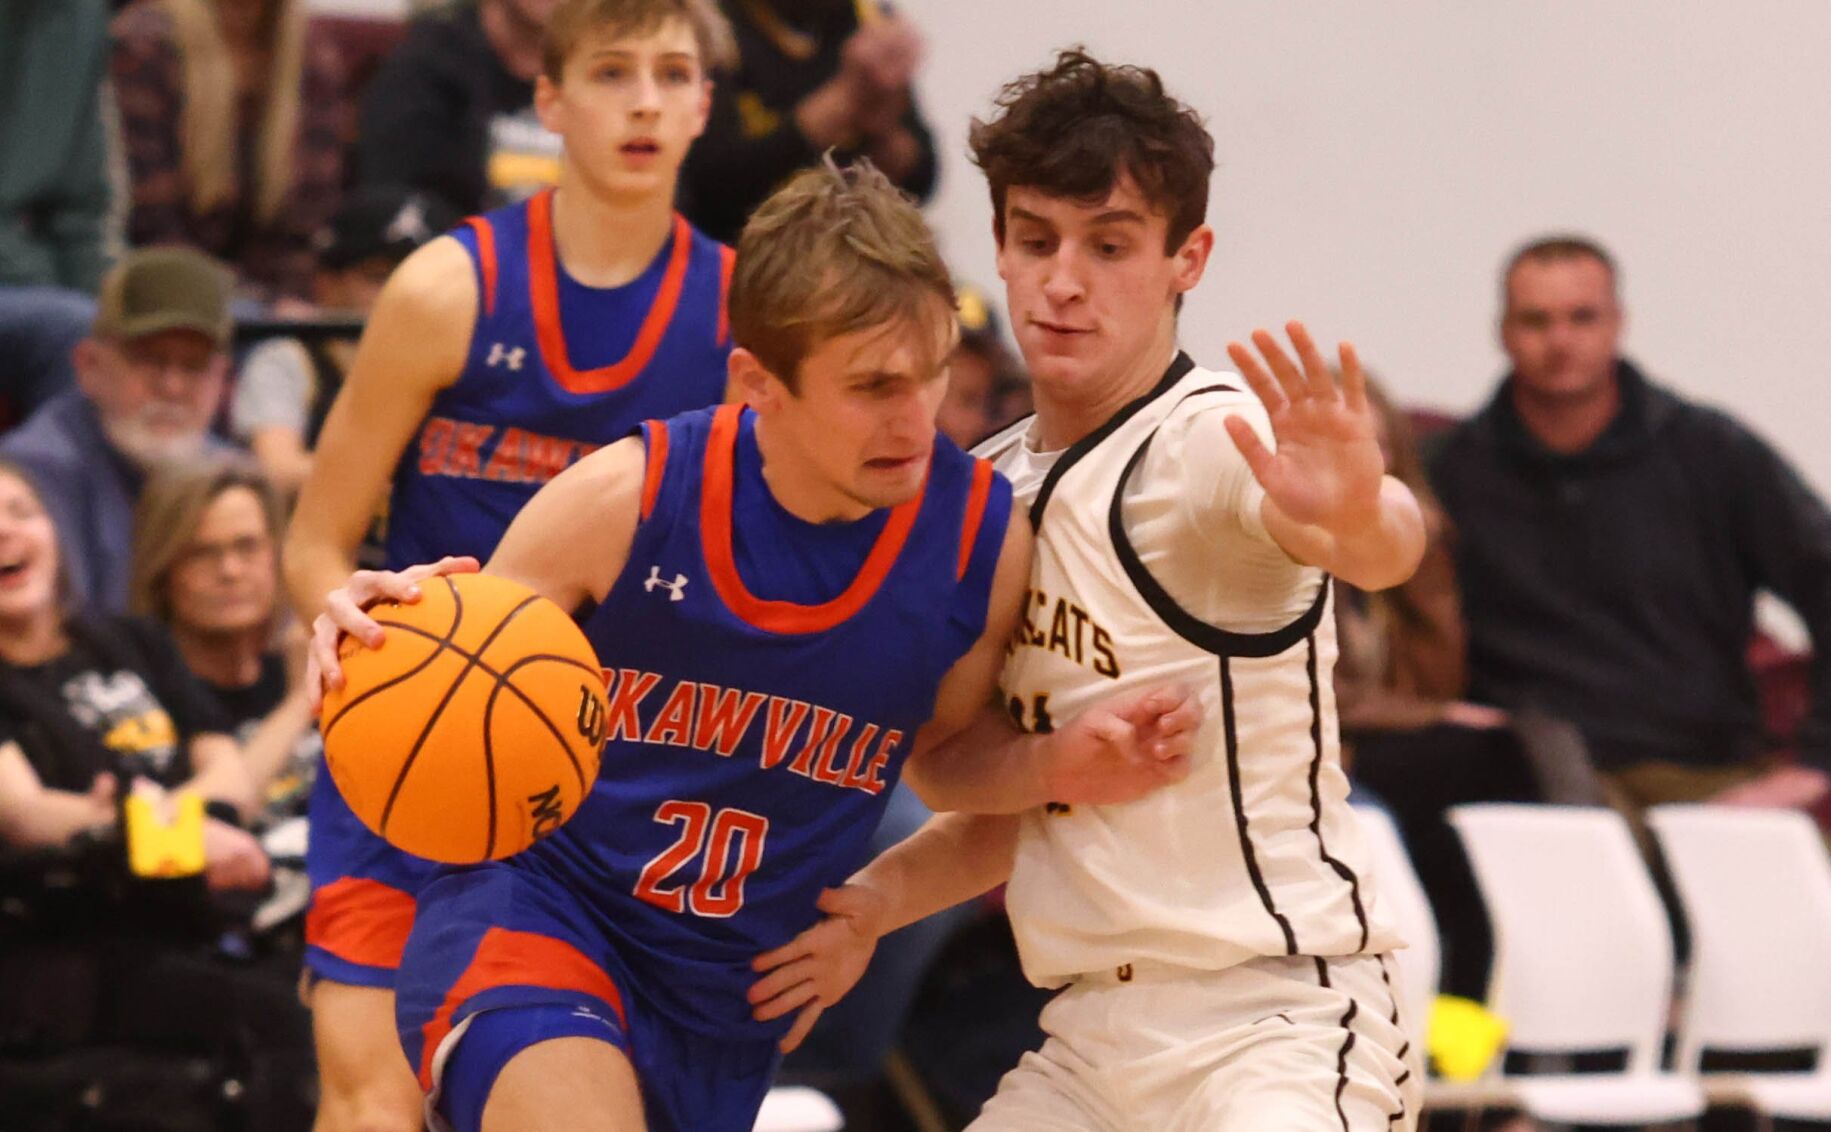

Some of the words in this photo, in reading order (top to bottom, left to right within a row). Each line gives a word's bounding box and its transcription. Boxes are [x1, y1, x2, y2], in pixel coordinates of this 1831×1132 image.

[419, 416, 602, 484] OKAW
[1005, 587, 1121, 680] CATS
[632, 799, 770, 919] 20
